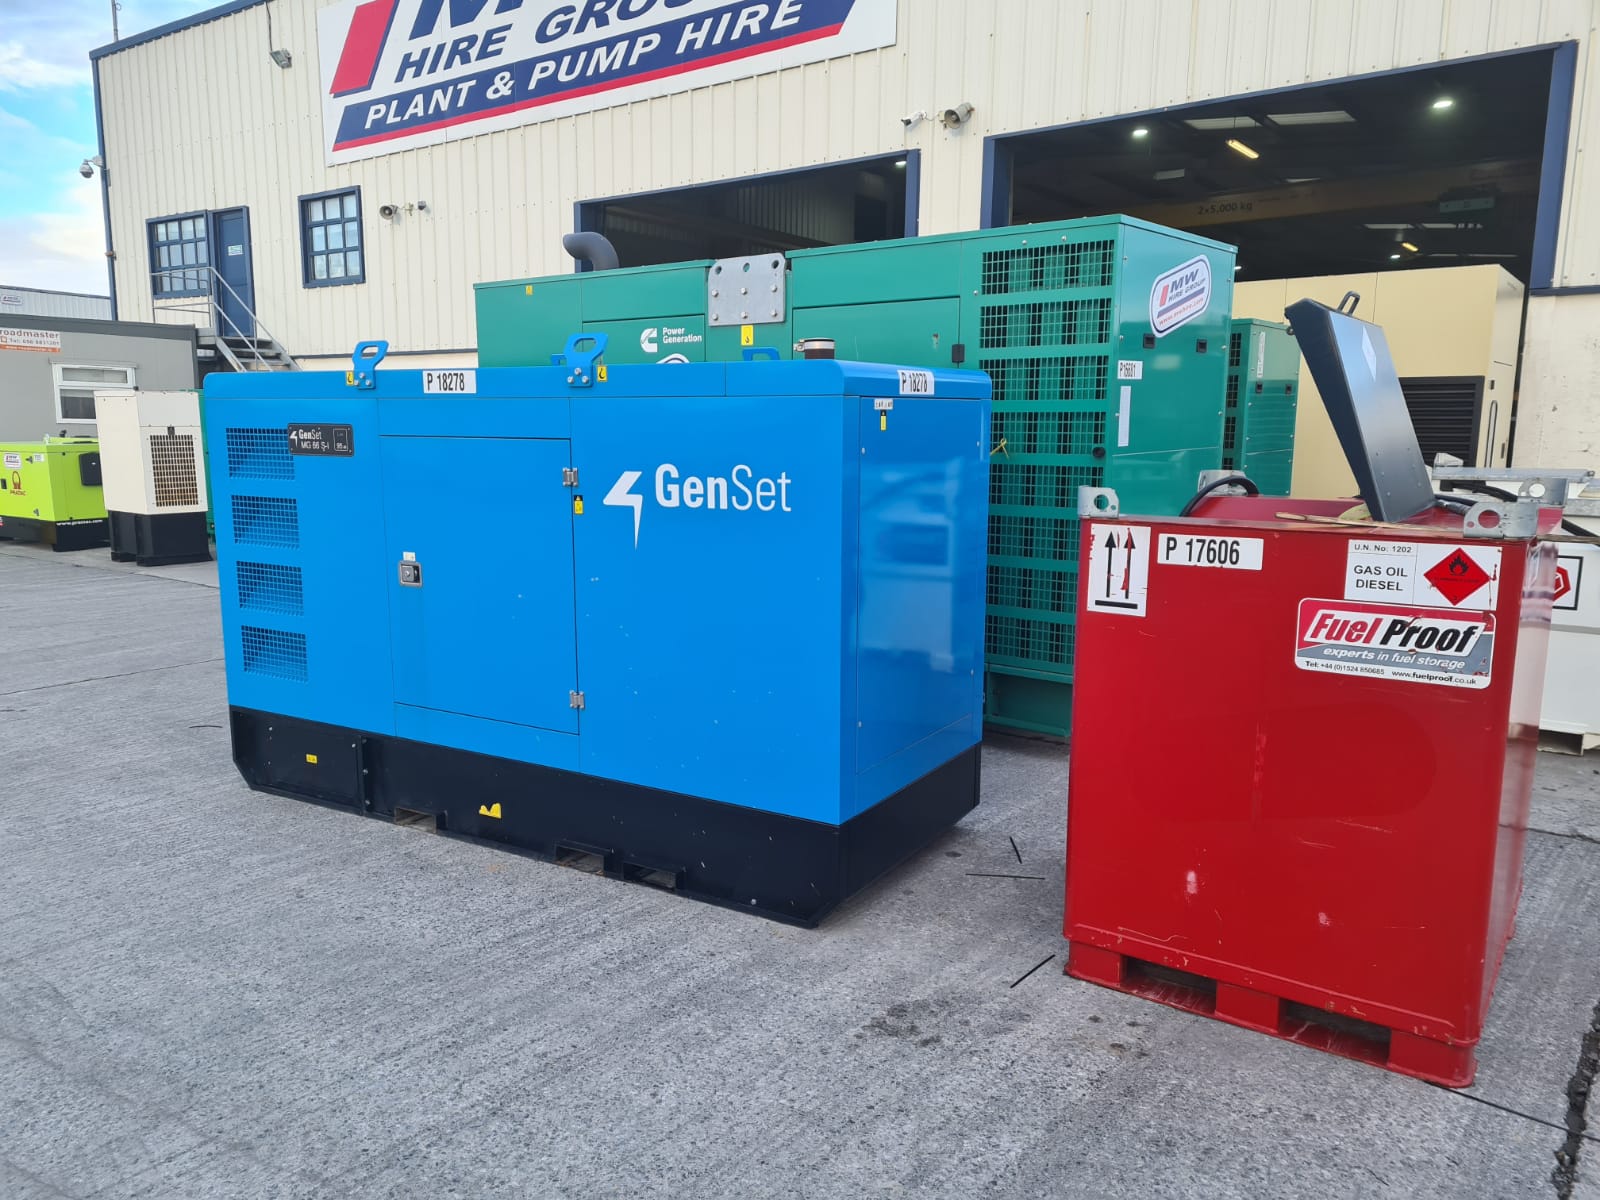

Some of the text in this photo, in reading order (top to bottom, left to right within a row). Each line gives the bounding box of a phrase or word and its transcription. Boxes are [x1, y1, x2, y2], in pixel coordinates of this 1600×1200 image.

[394, 23, 513, 84] HIRE
[364, 0, 802, 129] PLANT & PUMP HIRE
[1170, 268, 1199, 293] MW
[662, 327, 685, 335] Power
[662, 333, 702, 344] Generation
[427, 372, 465, 392] P 18278
[901, 372, 928, 393] P 18278
[298, 429, 322, 440] GenSet
[655, 463, 792, 512] GenSet
[1166, 537, 1240, 565] P 17606
[1392, 545, 1412, 553] 1202
[1354, 565, 1408, 577] GAS OIL
[1355, 579, 1403, 591] DIESEL
[1310, 613, 1478, 653] Fuel Proof
[1323, 647, 1466, 669] experts in fuel storage
[1392, 670, 1477, 685] www.fuelproof.co.uk
